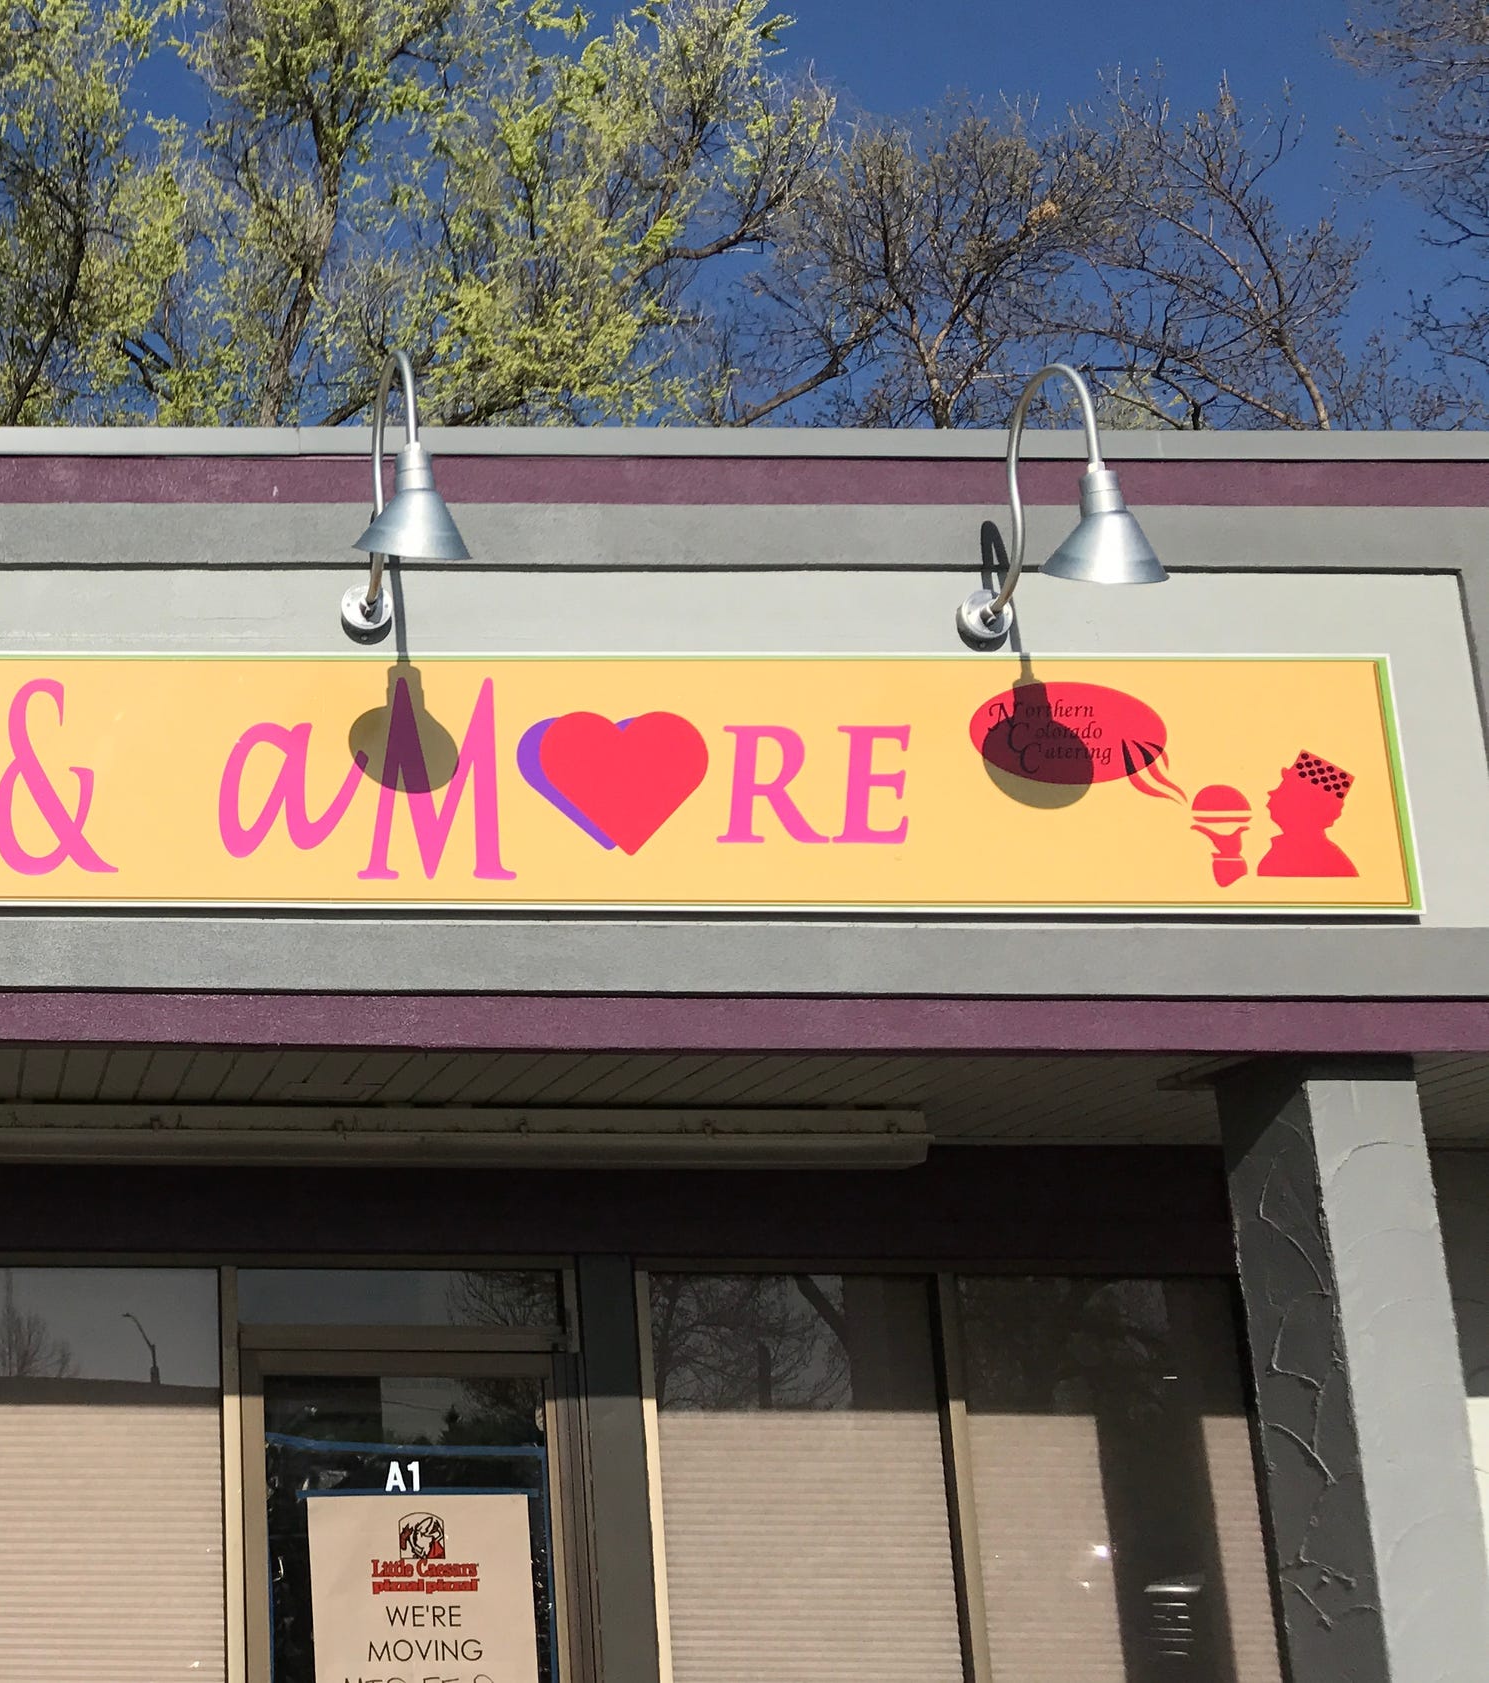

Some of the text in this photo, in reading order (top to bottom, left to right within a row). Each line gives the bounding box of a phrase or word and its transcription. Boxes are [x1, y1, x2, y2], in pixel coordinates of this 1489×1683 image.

[988, 698, 1094, 732] Northern
[1007, 720, 1103, 752] Colorado
[1020, 742, 1112, 774] Catering
[218, 677, 911, 880] aMRE
[385, 1460, 421, 1492] A1
[371, 1558, 479, 1578] Little Caesars
[386, 1605, 462, 1627] WE'RE
[368, 1639, 483, 1662] MOVING
